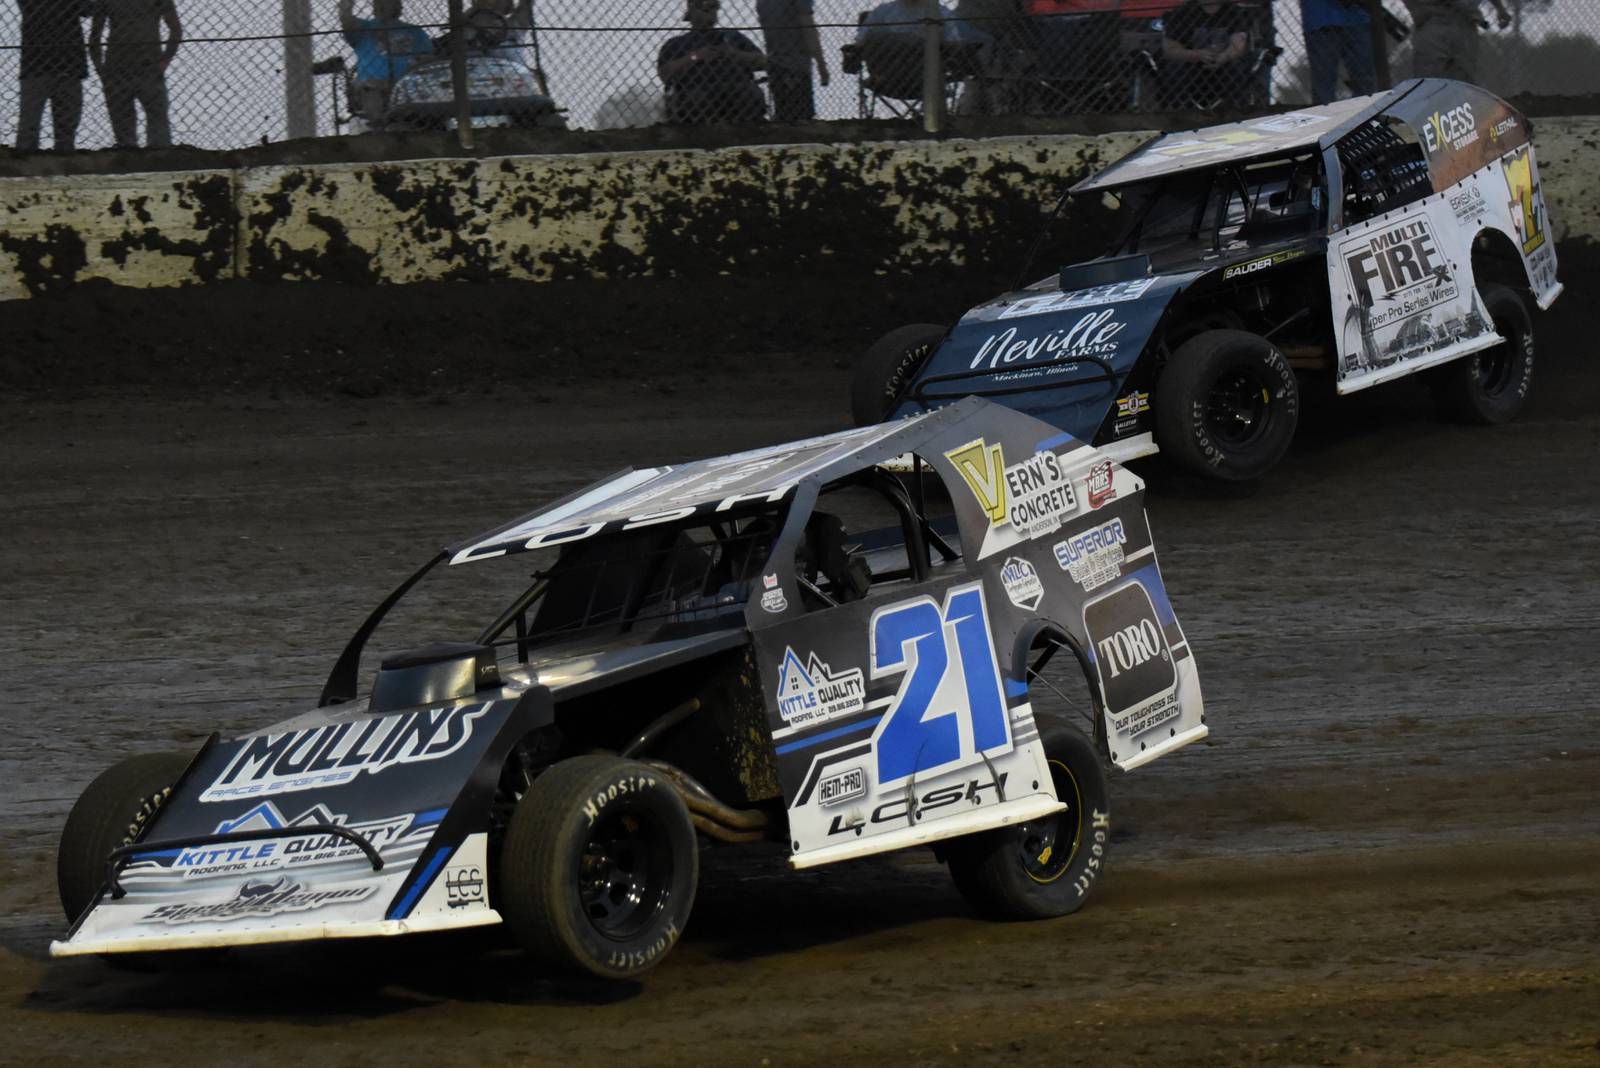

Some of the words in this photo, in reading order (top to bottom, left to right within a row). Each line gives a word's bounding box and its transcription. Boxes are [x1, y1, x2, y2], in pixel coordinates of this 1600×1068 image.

[1422, 102, 1475, 152] EXCESS
[1369, 221, 1426, 252] MULTI
[1226, 259, 1272, 279] SAUDER
[1347, 234, 1437, 307] FIRE
[1387, 307, 1403, 319] Pro
[1403, 296, 1429, 313] Series
[1429, 286, 1455, 302] Wires
[970, 308, 1127, 369] Neville
[1010, 483, 1074, 527] CONCRETE
[1056, 521, 1124, 567] SUPERIOR
[1098, 618, 1160, 678] TORO
[780, 692, 818, 716] KITTLE
[818, 677, 861, 704] QUALITY
[873, 583, 1010, 788] 21
[1115, 716, 1129, 730] OUR
[1130, 697, 1166, 722] TOUGHNESS
[1129, 720, 1146, 736] YOUR
[1147, 703, 1179, 727] STRENGTH
[216, 699, 494, 784] MULLINS
[582, 776, 656, 827] Hoosier
[178, 843, 278, 866] KITTLE
[253, 858, 281, 868] LLC
[1073, 807, 1109, 897] Hoosier
